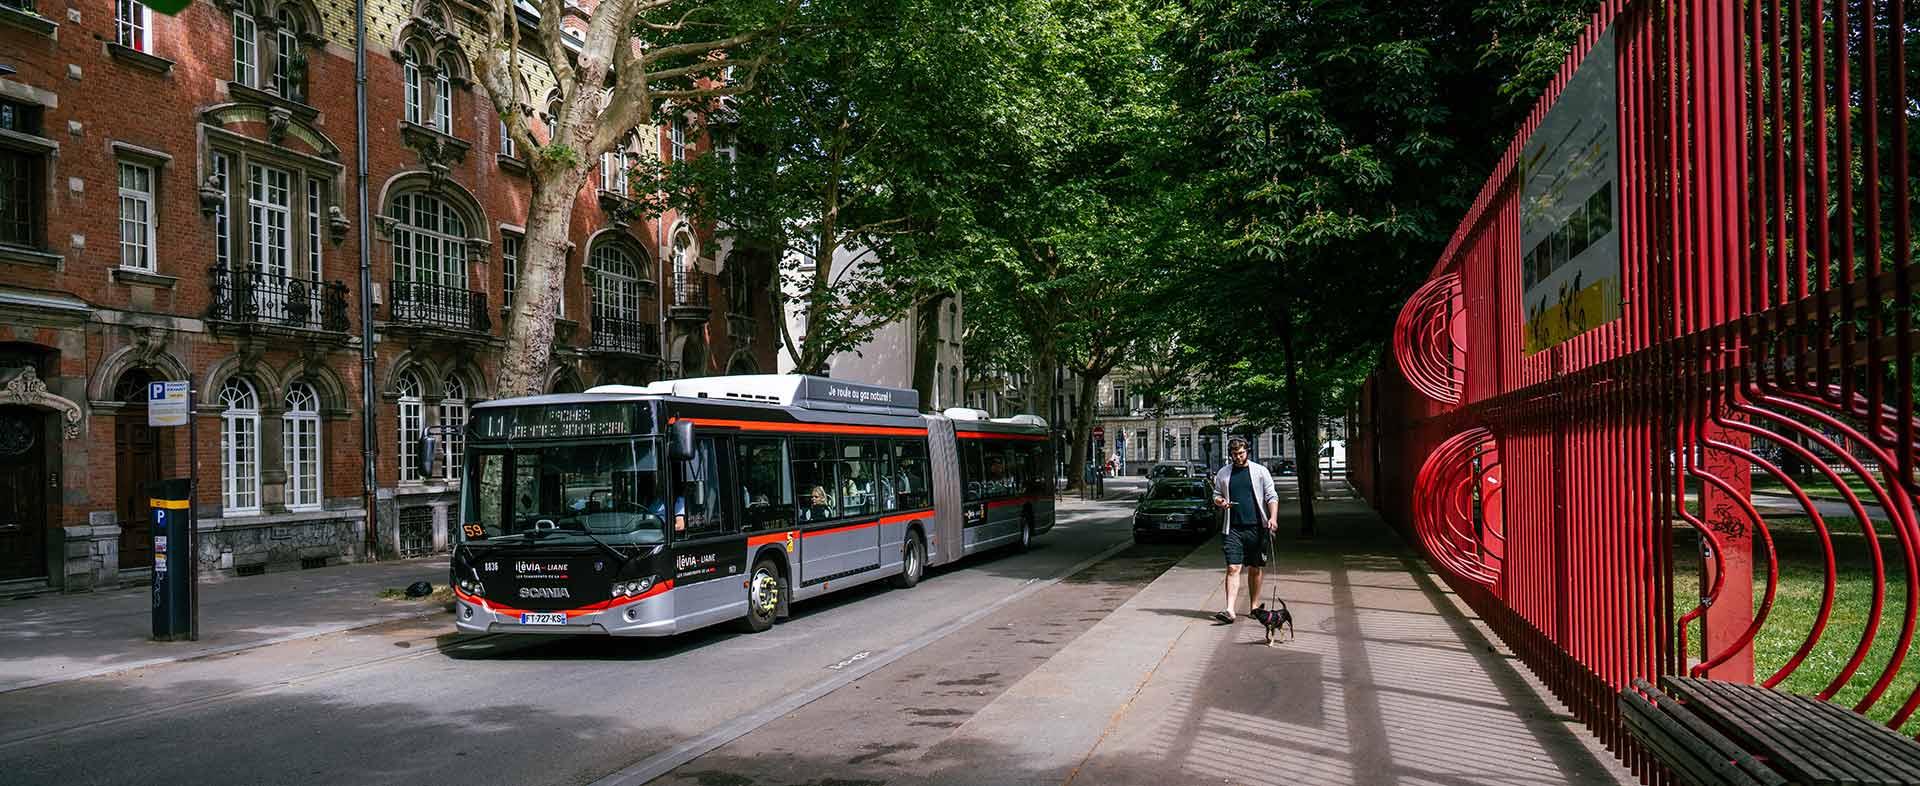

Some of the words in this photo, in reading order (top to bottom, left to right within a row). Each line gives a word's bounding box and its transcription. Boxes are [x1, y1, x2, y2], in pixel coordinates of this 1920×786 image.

[153, 384, 163, 398] P
[828, 385, 836, 396] Je
[837, 386, 851, 398] roule
[157, 510, 165, 524] P
[463, 524, 483, 537] 59
[519, 587, 571, 599] SCANIA
